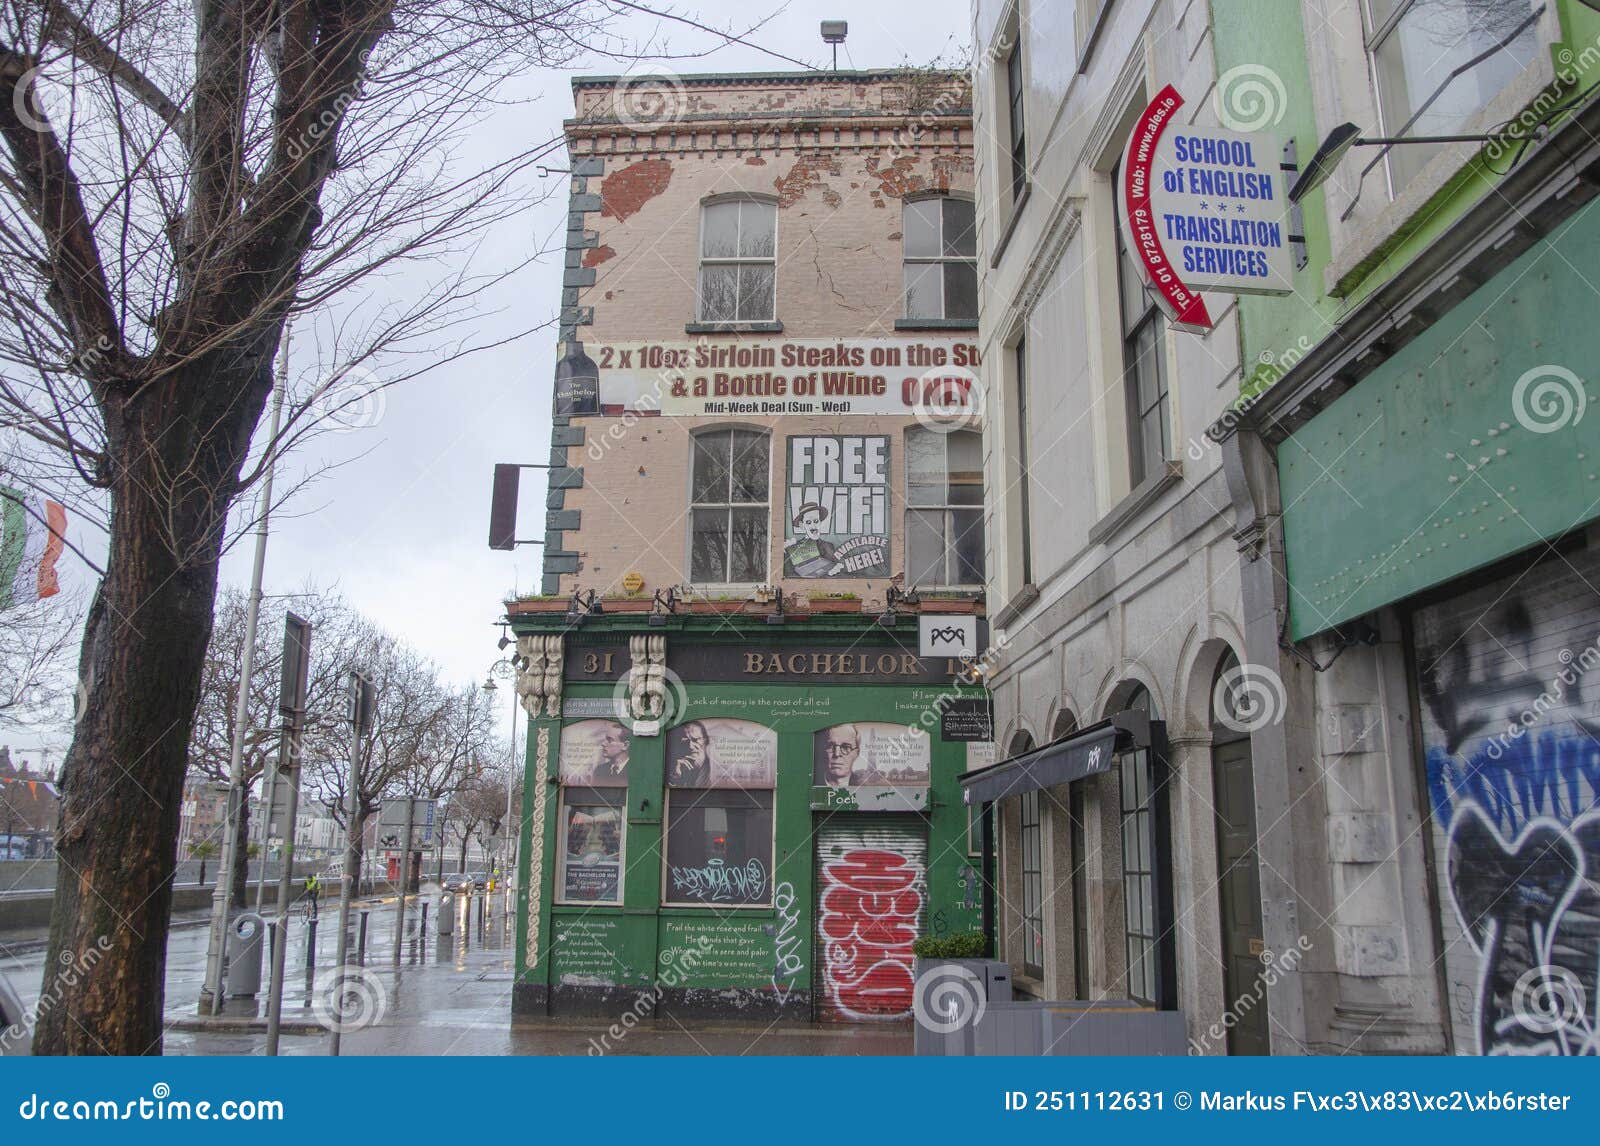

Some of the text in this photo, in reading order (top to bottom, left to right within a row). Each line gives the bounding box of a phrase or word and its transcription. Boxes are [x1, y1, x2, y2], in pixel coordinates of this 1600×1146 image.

[1174, 135, 1256, 168] SCHOOL
[1163, 167, 1274, 201] of ENGLISH
[1132, 97, 1191, 311] Tel: 01 8728179 Web: www.ales.ie
[1163, 214, 1281, 247] TRANSLATION
[1182, 245, 1269, 278] SERVICES
[600, 346, 614, 369] 2
[618, 349, 632, 369] x
[696, 344, 775, 369] Sirloin
[781, 343, 864, 367] Steaks
[870, 348, 900, 367] on
[906, 344, 947, 367] the
[671, 372, 886, 397] & a Bottle of Wine
[901, 377, 973, 407] ONLY
[704, 402, 760, 414] Mid-Week
[761, 402, 786, 413] Deal
[788, 401, 813, 414] (Sun
[822, 401, 851, 414] Wed)
[792, 437, 886, 484] FREE
[790, 486, 885, 534] WiFi
[834, 535, 888, 560] AVAILABLE
[844, 548, 885, 573] HERE!
[584, 653, 614, 673] 31
[743, 653, 920, 676] BACHELOR
[687, 697, 706, 706] Lack
[758, 697, 770, 706] the
[666, 922, 683, 932] Frail
[684, 923, 695, 932] the
[747, 923, 762, 933] frail
